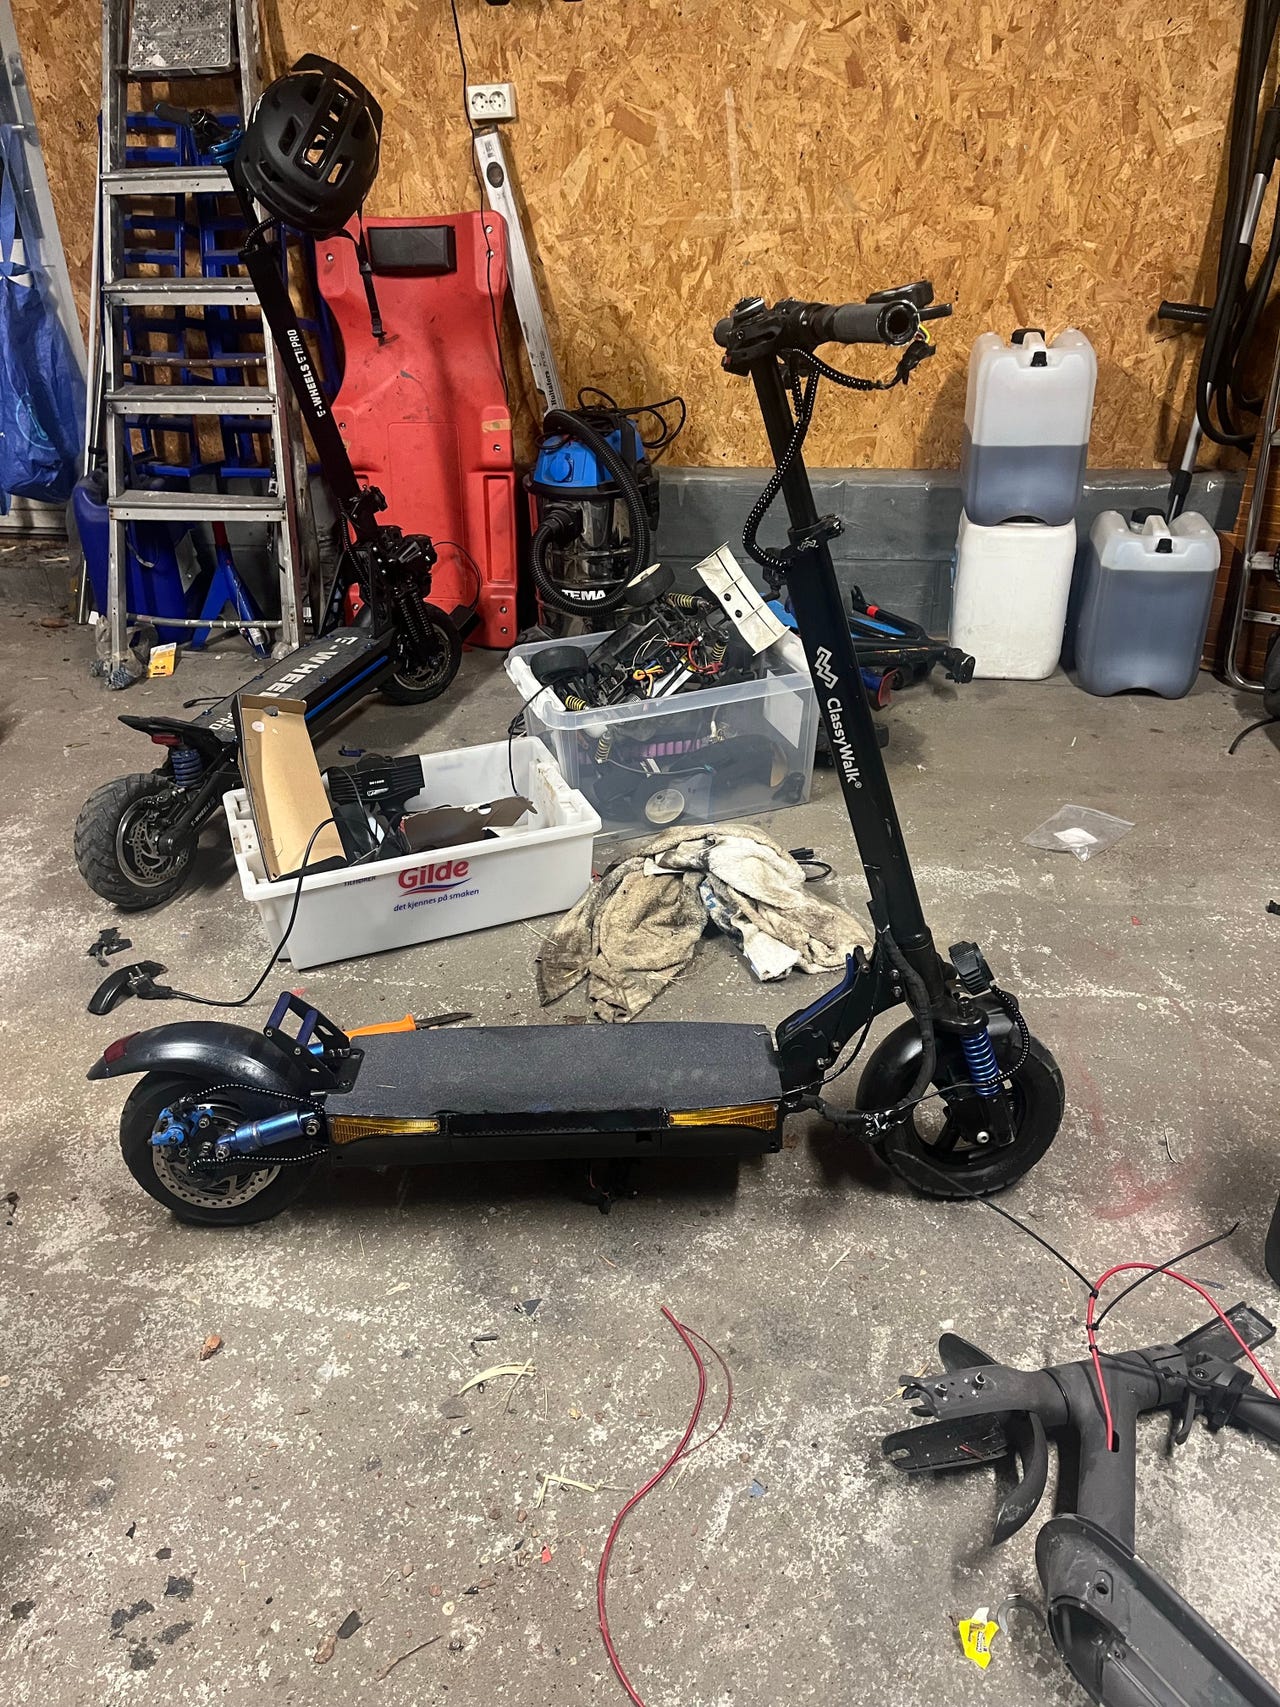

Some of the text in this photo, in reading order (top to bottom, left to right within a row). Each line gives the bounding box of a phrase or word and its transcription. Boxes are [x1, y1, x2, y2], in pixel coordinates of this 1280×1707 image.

[561, 589, 606, 601] TEMA
[258, 636, 359, 698] E-WHEEL
[398, 860, 470, 889] Gilde
[393, 888, 480, 912] det kjennes på smaken
